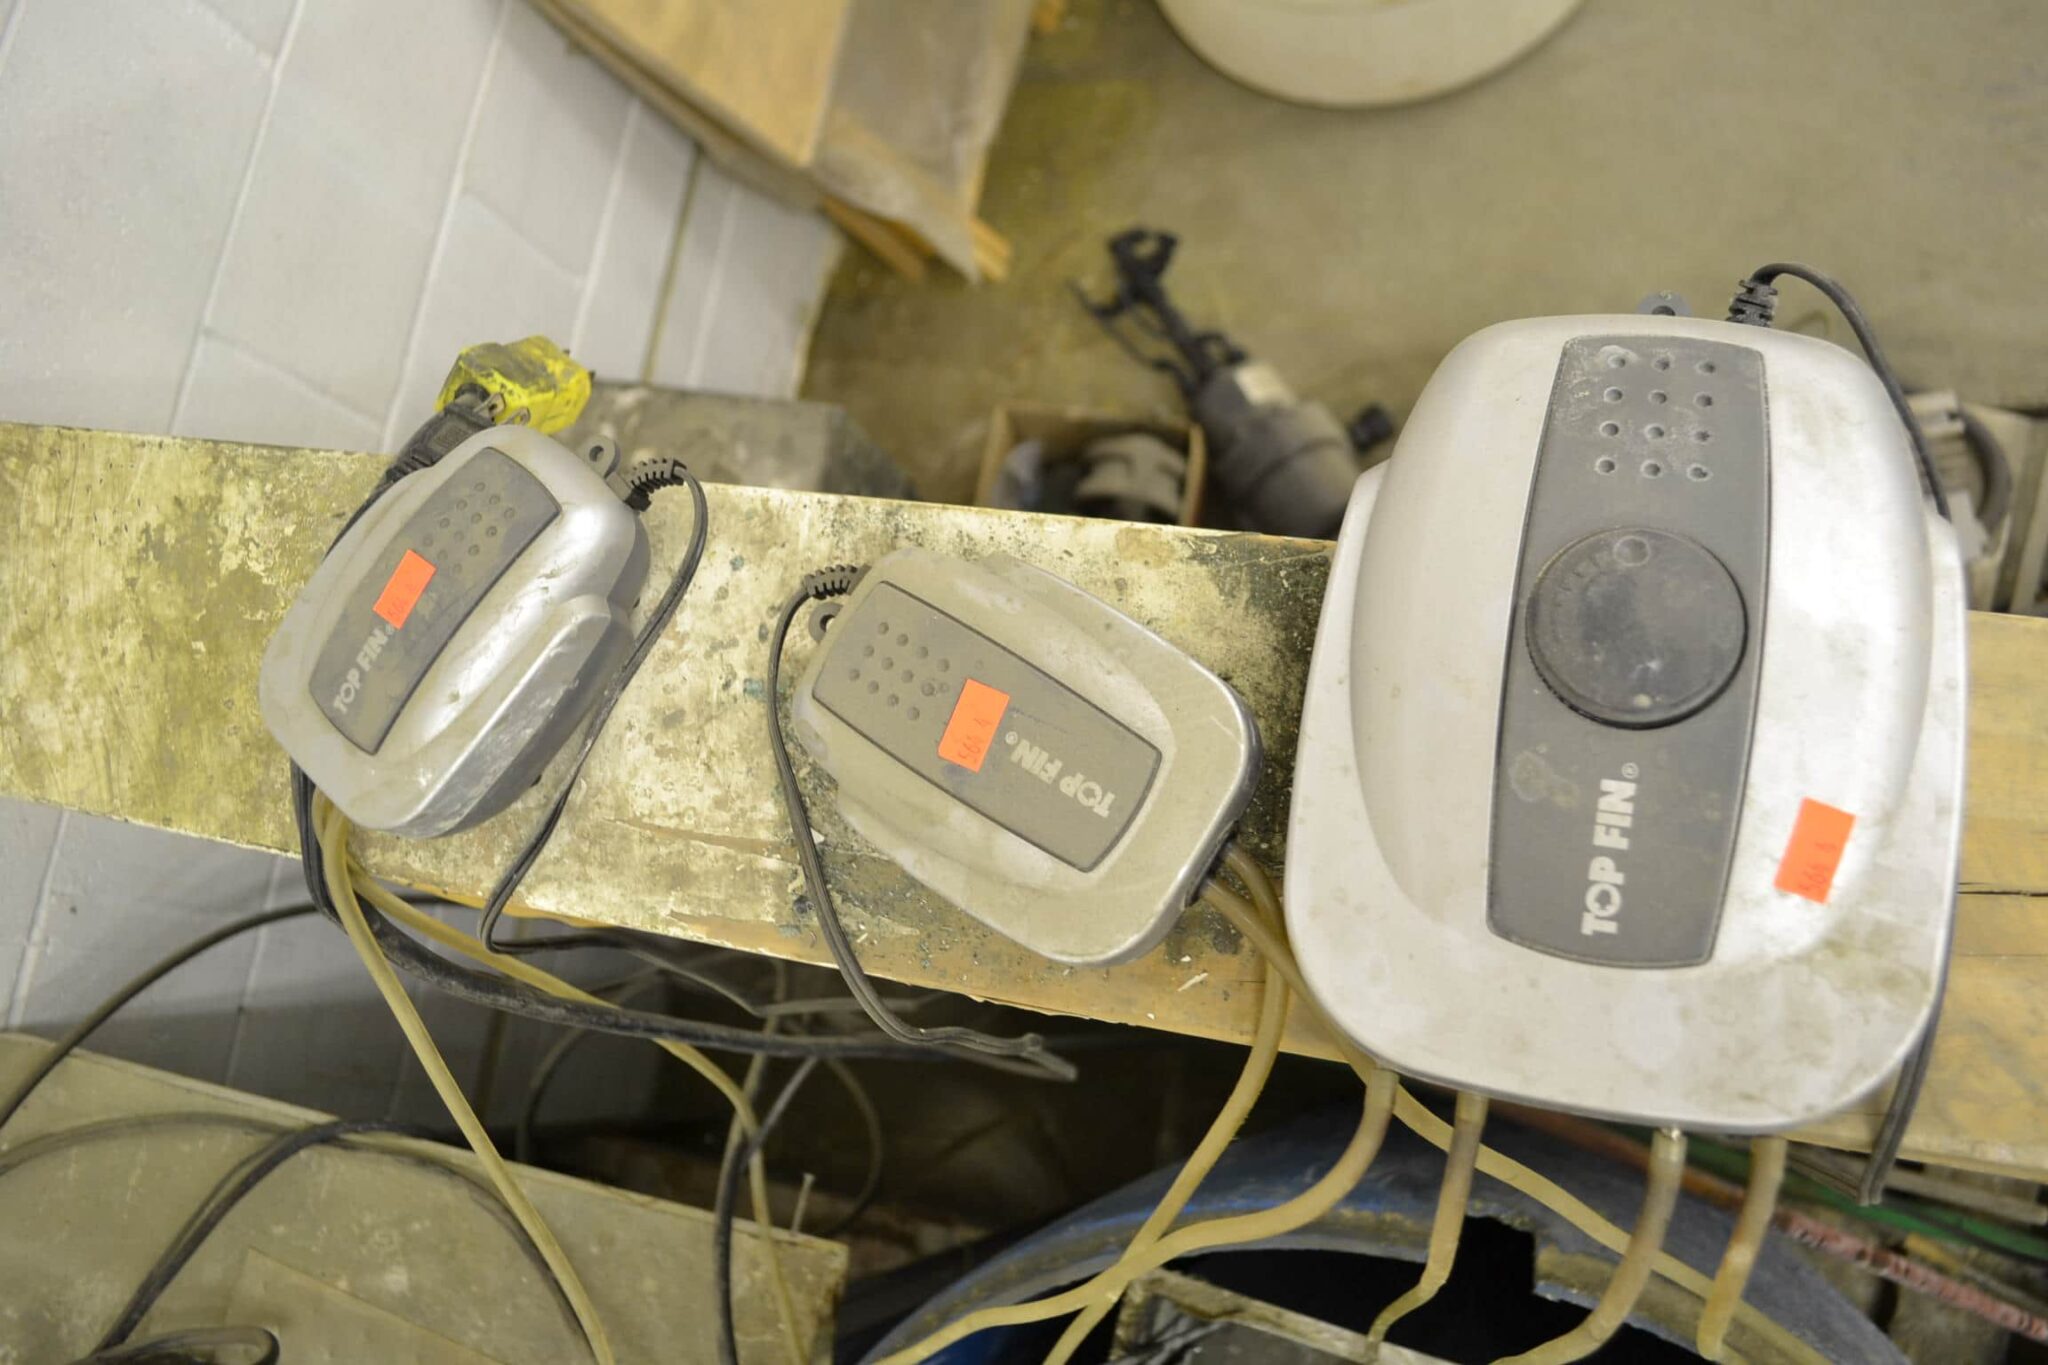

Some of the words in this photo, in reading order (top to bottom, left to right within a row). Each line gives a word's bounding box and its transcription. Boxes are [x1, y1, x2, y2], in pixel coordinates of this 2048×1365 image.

[332, 667, 361, 714] TOP
[356, 627, 388, 672] FIN
[1010, 738, 1063, 784] FIN
[1059, 772, 1116, 818] TOP
[1592, 778, 1638, 851] FIN
[1580, 856, 1625, 936] TOP
